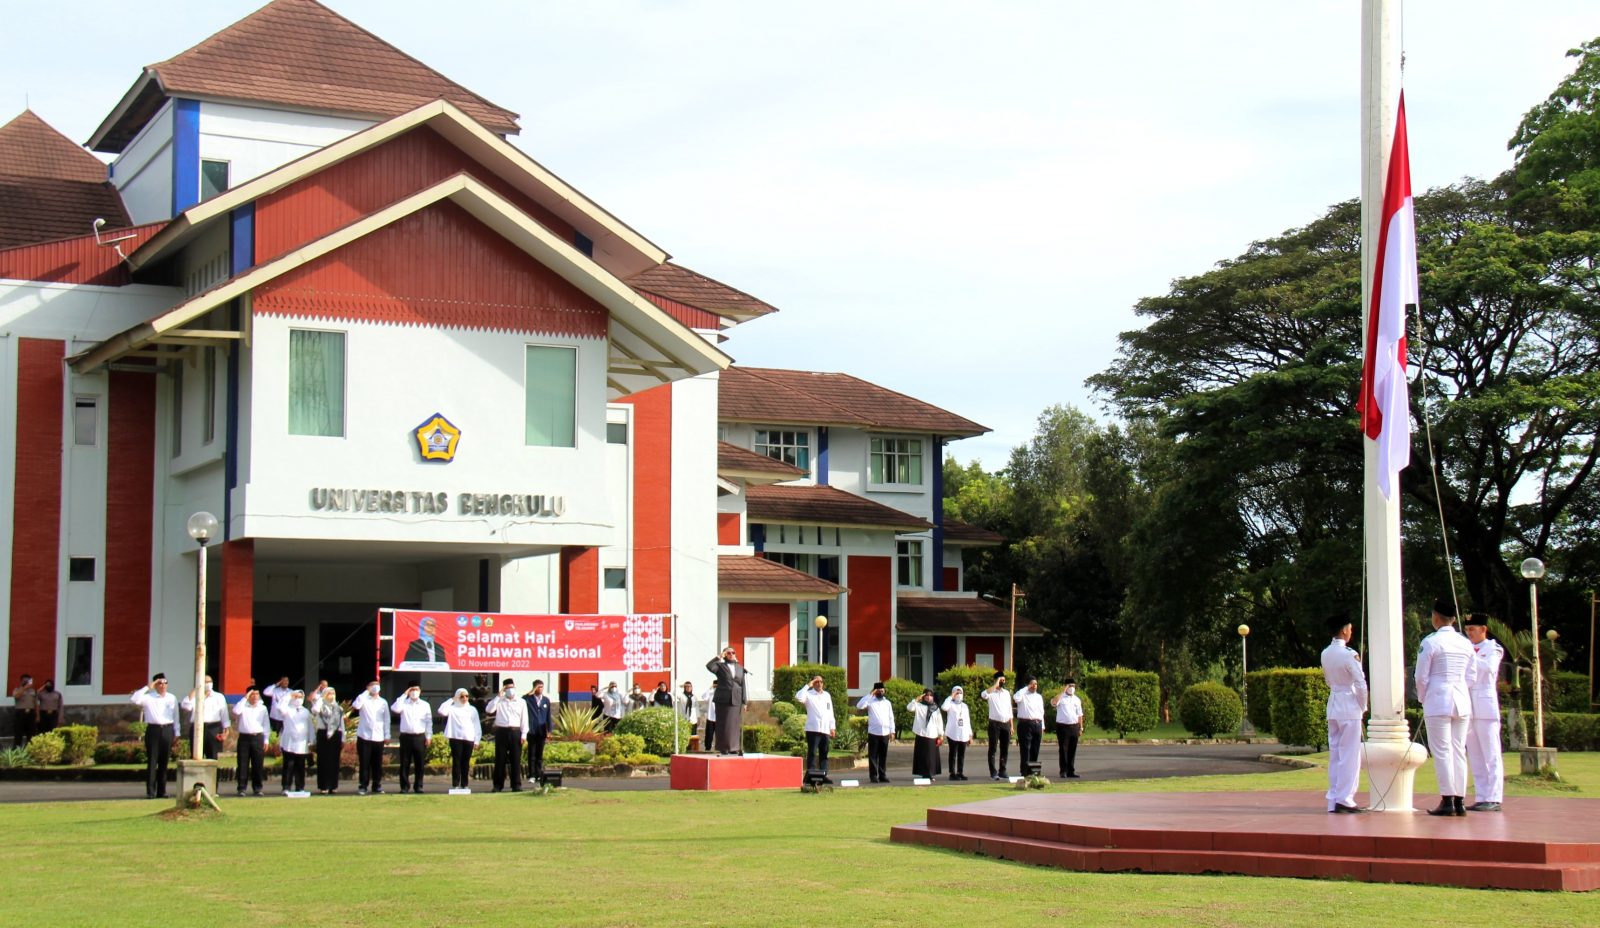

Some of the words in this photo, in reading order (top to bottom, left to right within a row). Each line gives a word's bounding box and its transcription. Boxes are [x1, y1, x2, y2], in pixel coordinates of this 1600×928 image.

[309, 487, 448, 514] UNIVERSITAS
[458, 493, 565, 517] BENGKULU
[457, 629, 520, 643] Selamat
[525, 630, 556, 644] Hari
[457, 644, 532, 658] Pahlawan
[537, 645, 601, 659] Nasional
[457, 659, 466, 667] 10
[468, 659, 509, 668] November
[511, 660, 530, 668] 2022
